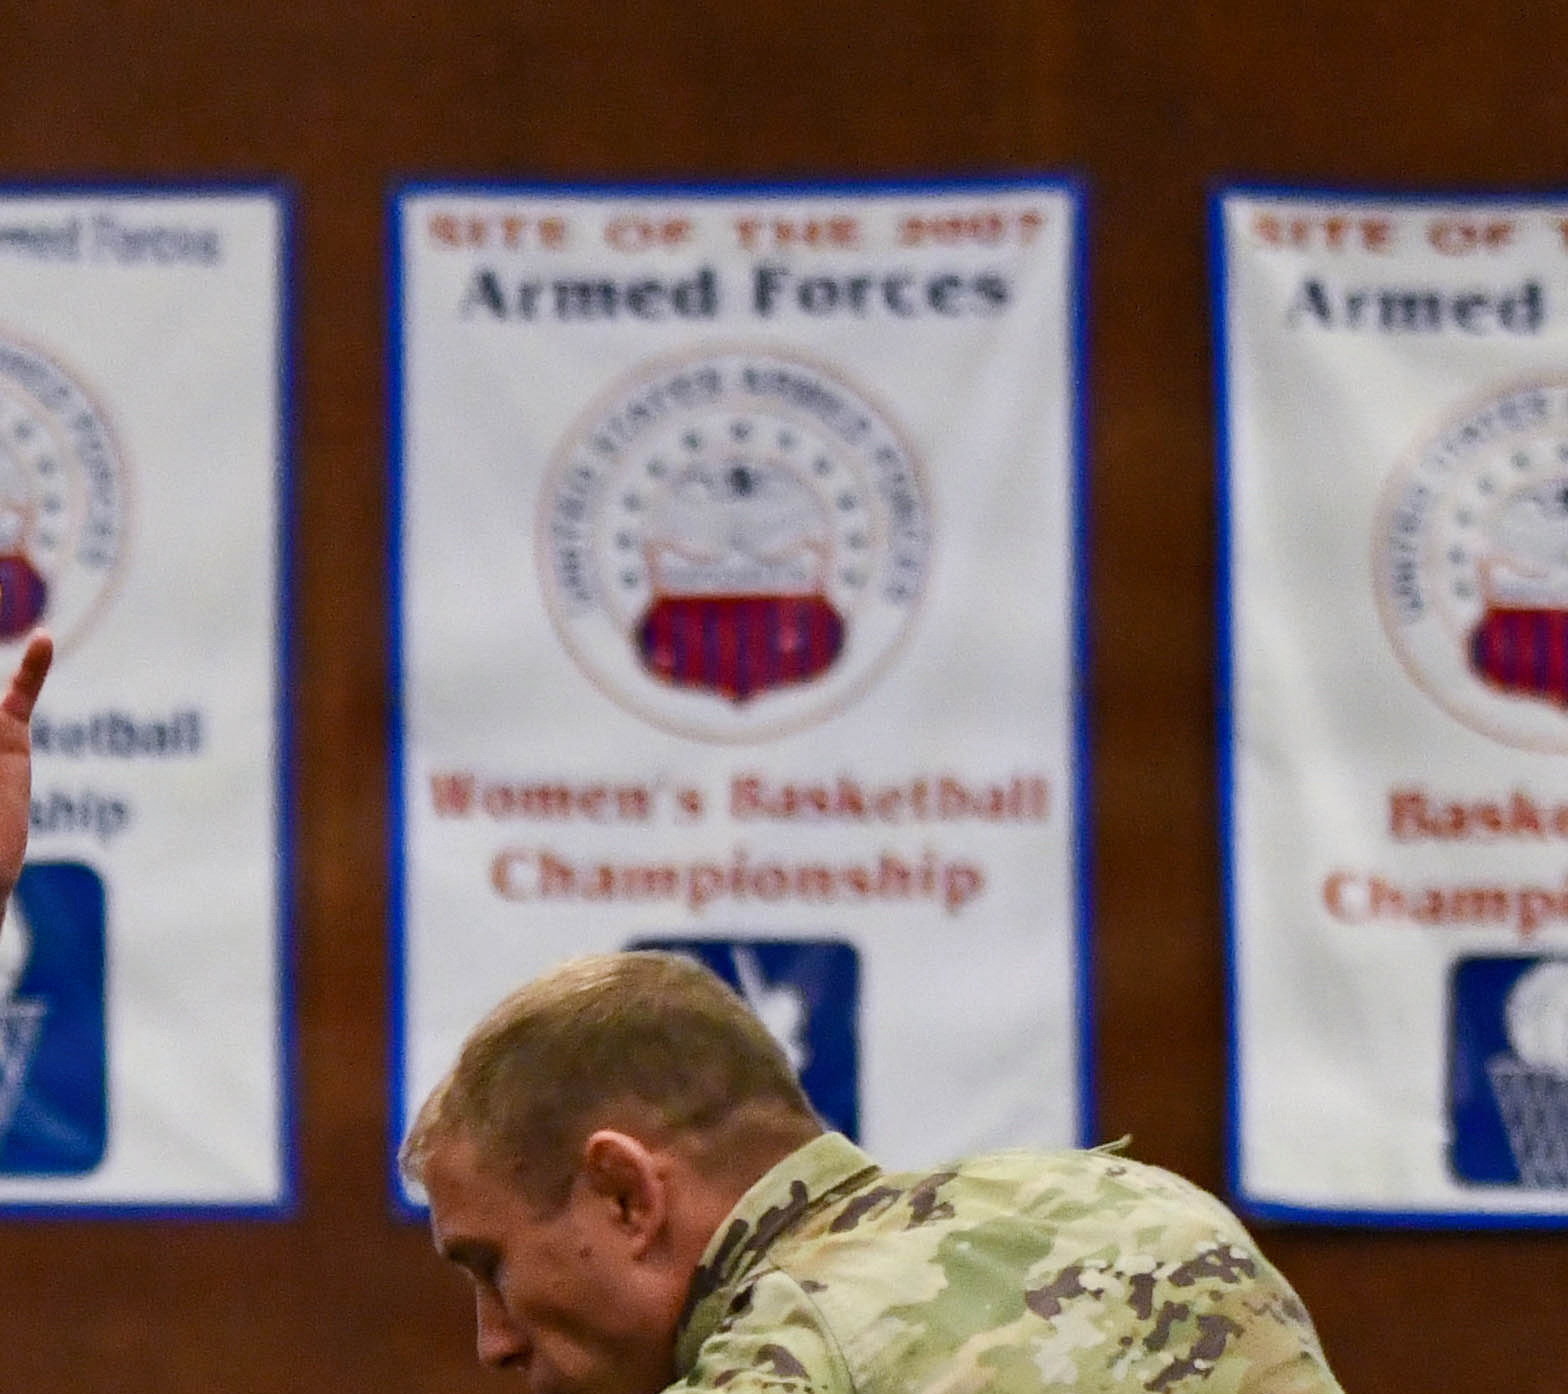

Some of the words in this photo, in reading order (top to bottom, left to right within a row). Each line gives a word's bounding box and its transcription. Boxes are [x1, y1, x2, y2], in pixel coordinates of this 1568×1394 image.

[428, 213, 566, 251] SITE
[603, 214, 690, 251] OF
[733, 213, 862, 249] THE
[1253, 213, 1390, 254] SITE
[1428, 216, 1514, 256] OF
[466, 266, 717, 321] Armed
[750, 266, 1011, 319] Forces
[1288, 277, 1544, 332] Armed
[431, 774, 704, 820] Women's
[730, 773, 1049, 822] Basketball
[490, 847, 986, 914] Championship
